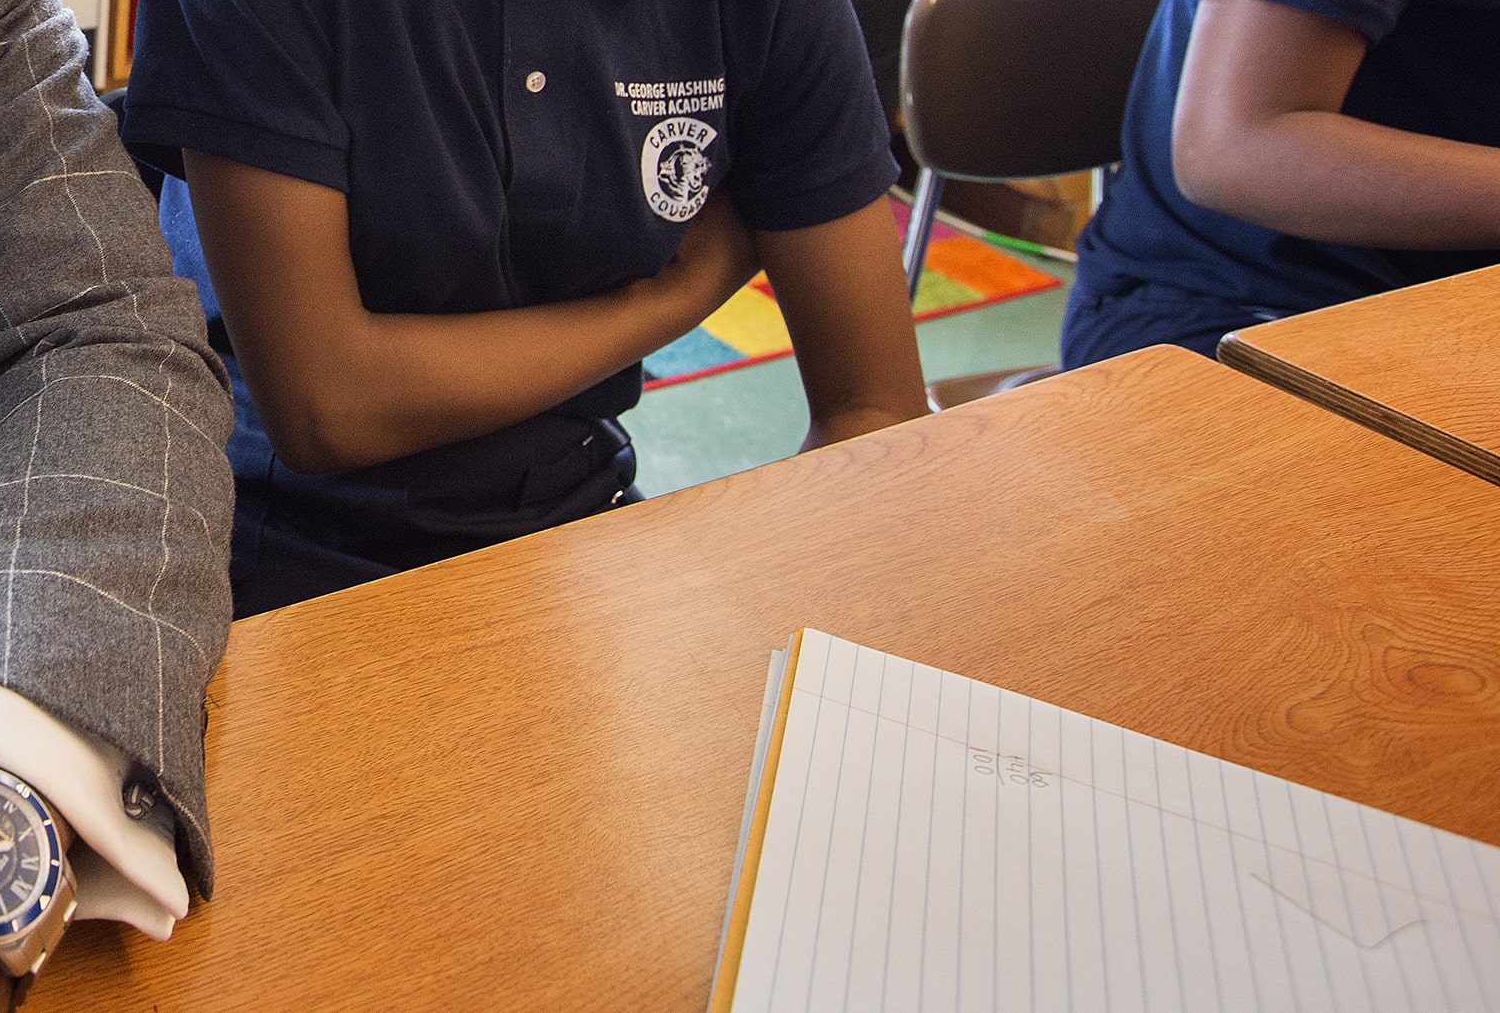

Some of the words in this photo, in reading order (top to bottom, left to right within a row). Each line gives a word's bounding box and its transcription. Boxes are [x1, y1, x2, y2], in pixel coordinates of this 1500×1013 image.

[628, 83, 665, 98] GEORGE
[631, 100, 666, 115] CARVER
[668, 94, 724, 114] ACADEMY
[649, 122, 708, 149] CARVER
